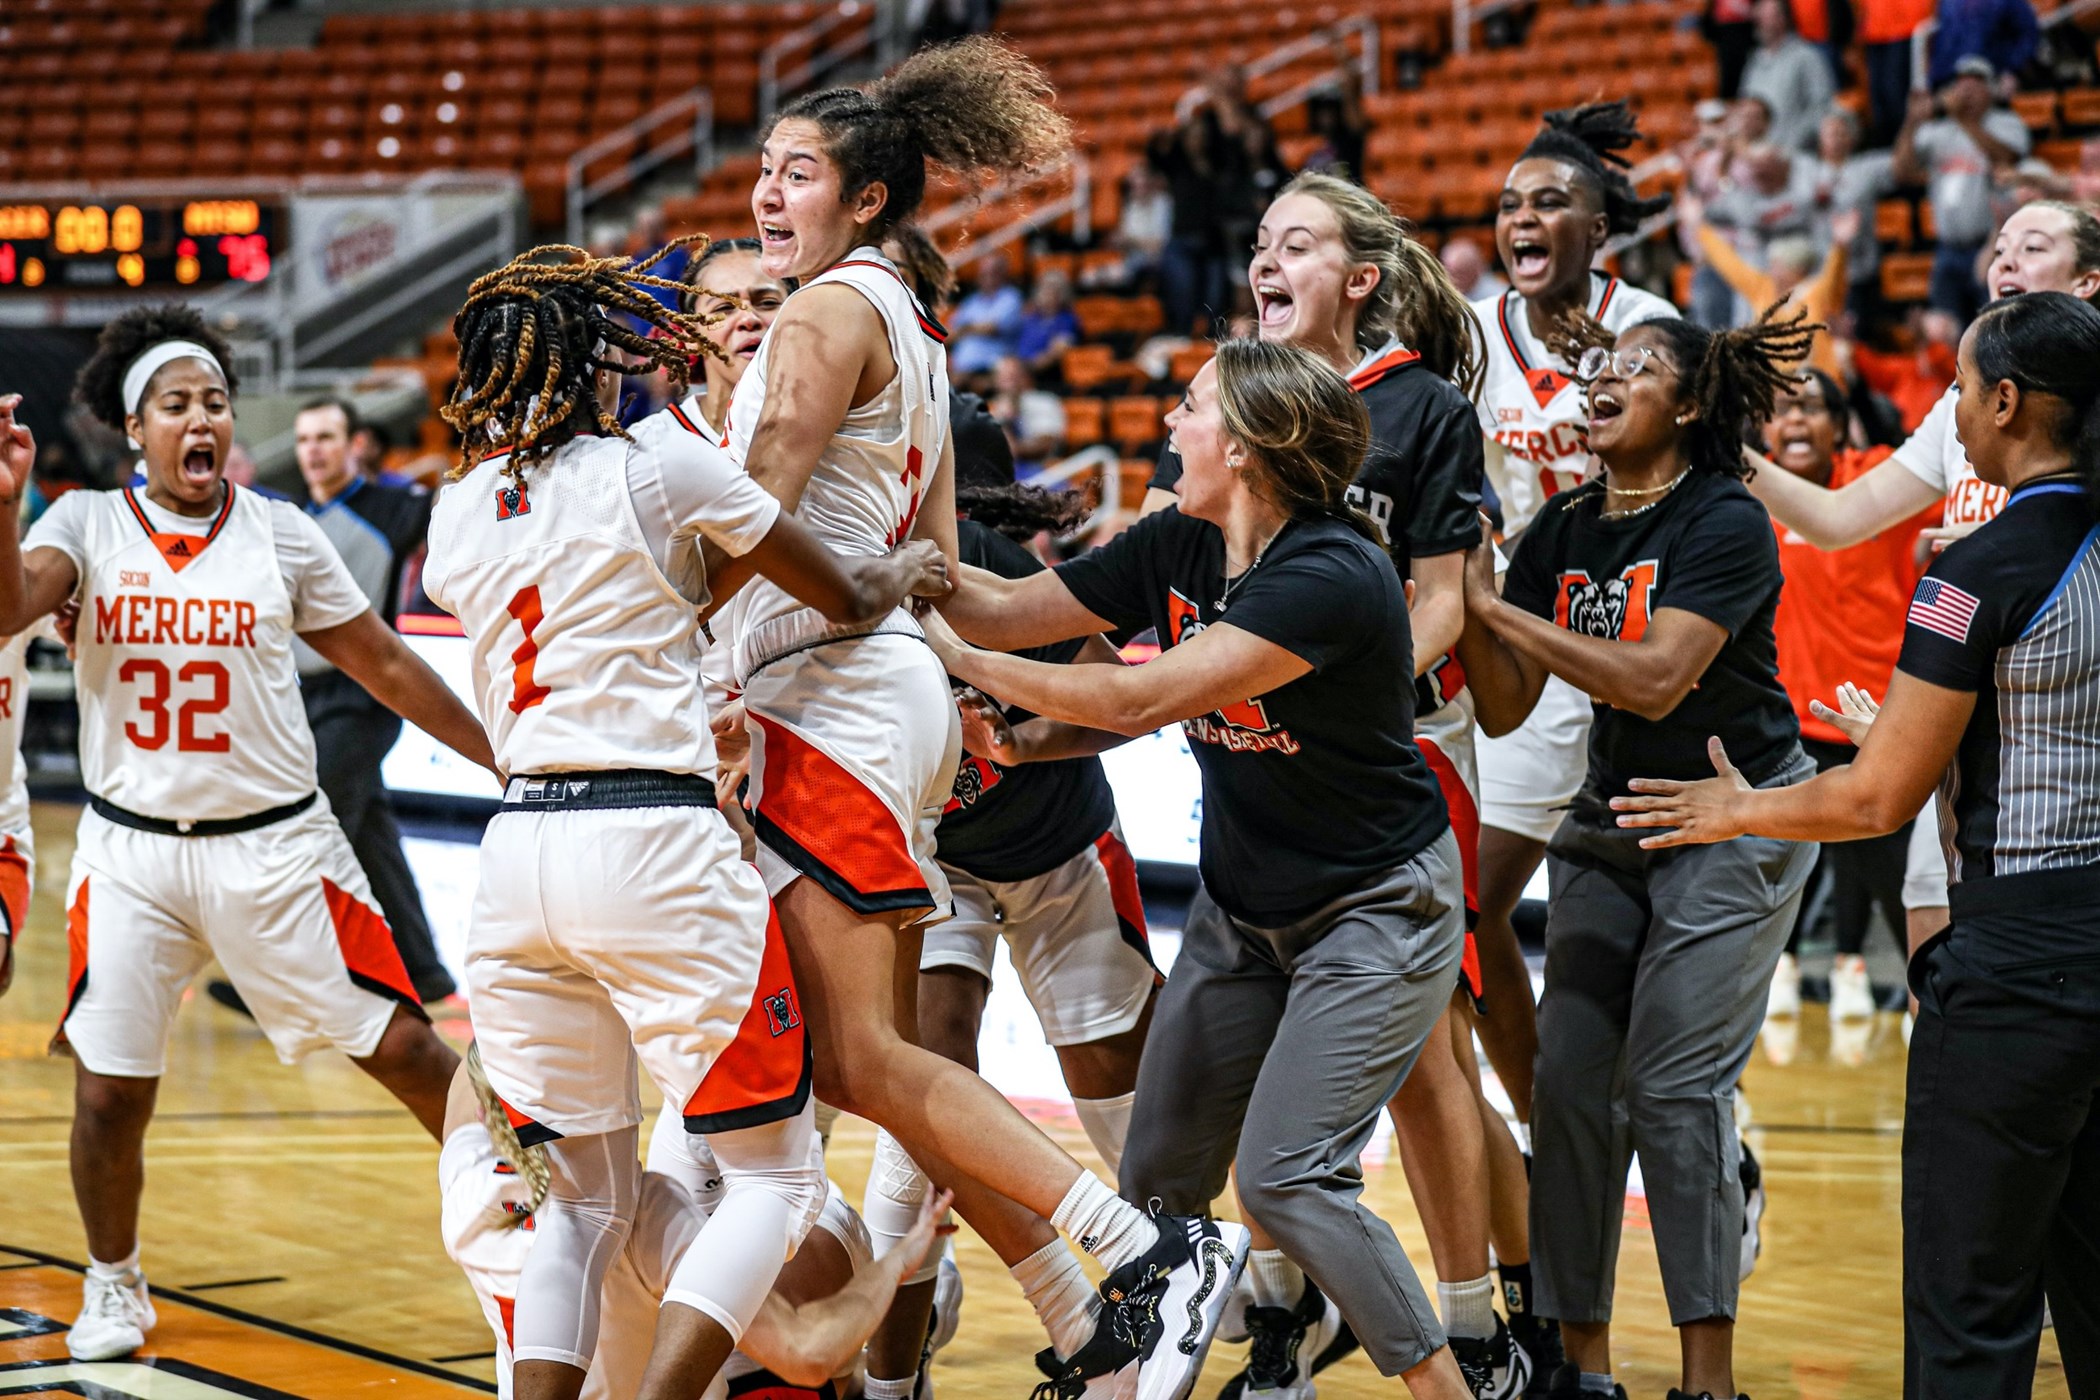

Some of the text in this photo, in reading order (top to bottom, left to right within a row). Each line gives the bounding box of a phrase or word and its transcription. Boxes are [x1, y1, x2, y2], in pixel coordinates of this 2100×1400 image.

[95, 595, 257, 649] MERCER
[507, 584, 552, 716] 1
[119, 658, 231, 753] 32
